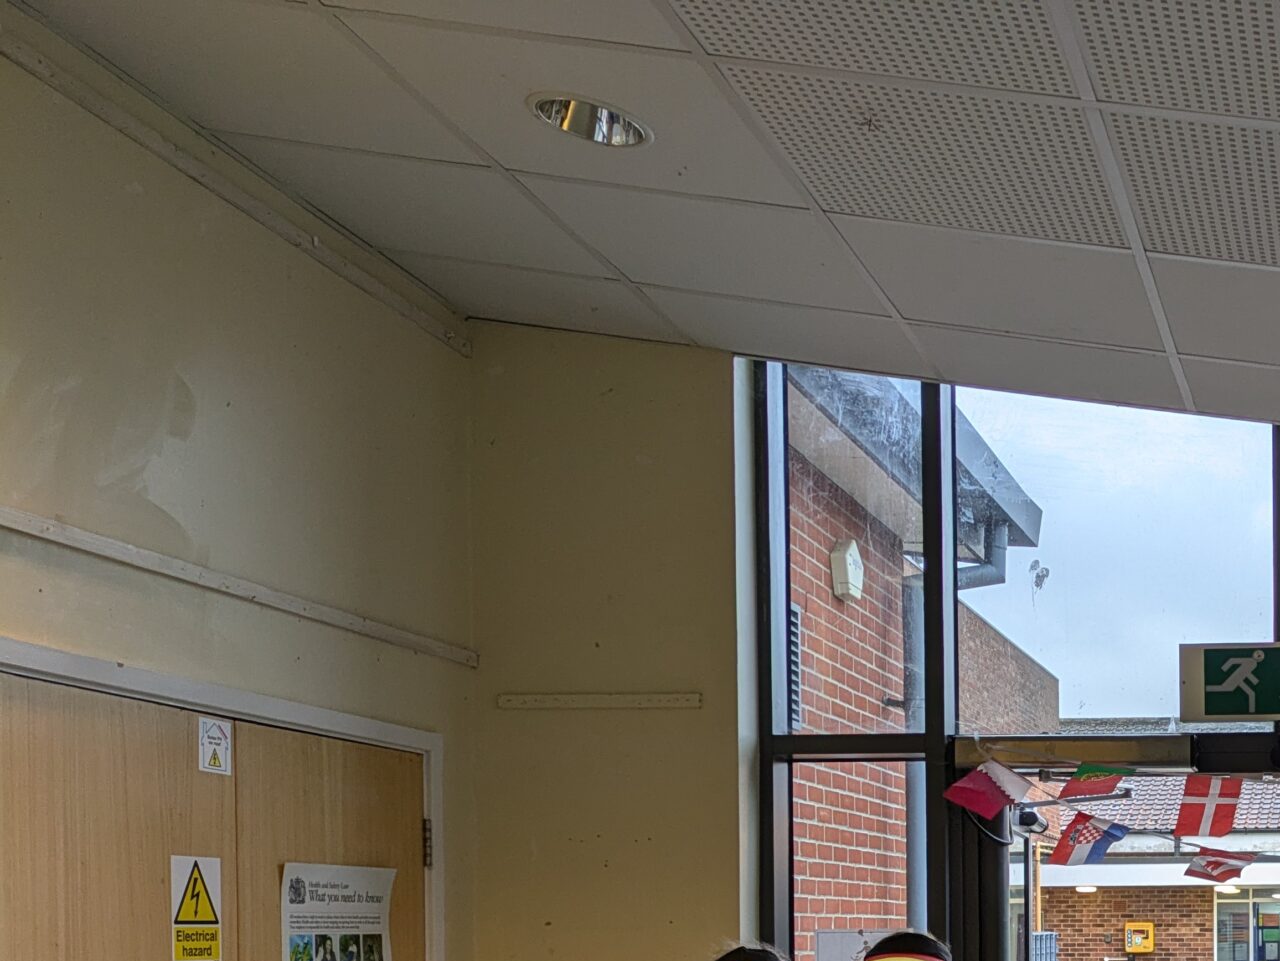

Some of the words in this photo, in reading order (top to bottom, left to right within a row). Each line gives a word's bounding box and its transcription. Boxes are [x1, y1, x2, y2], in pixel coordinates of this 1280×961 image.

[308, 889, 327, 902] What
[327, 893, 340, 906] you
[340, 890, 356, 903] need
[357, 892, 364, 904] to
[364, 891, 384, 904] know
[176, 930, 217, 943] Electrical
[182, 944, 212, 957] hazard
